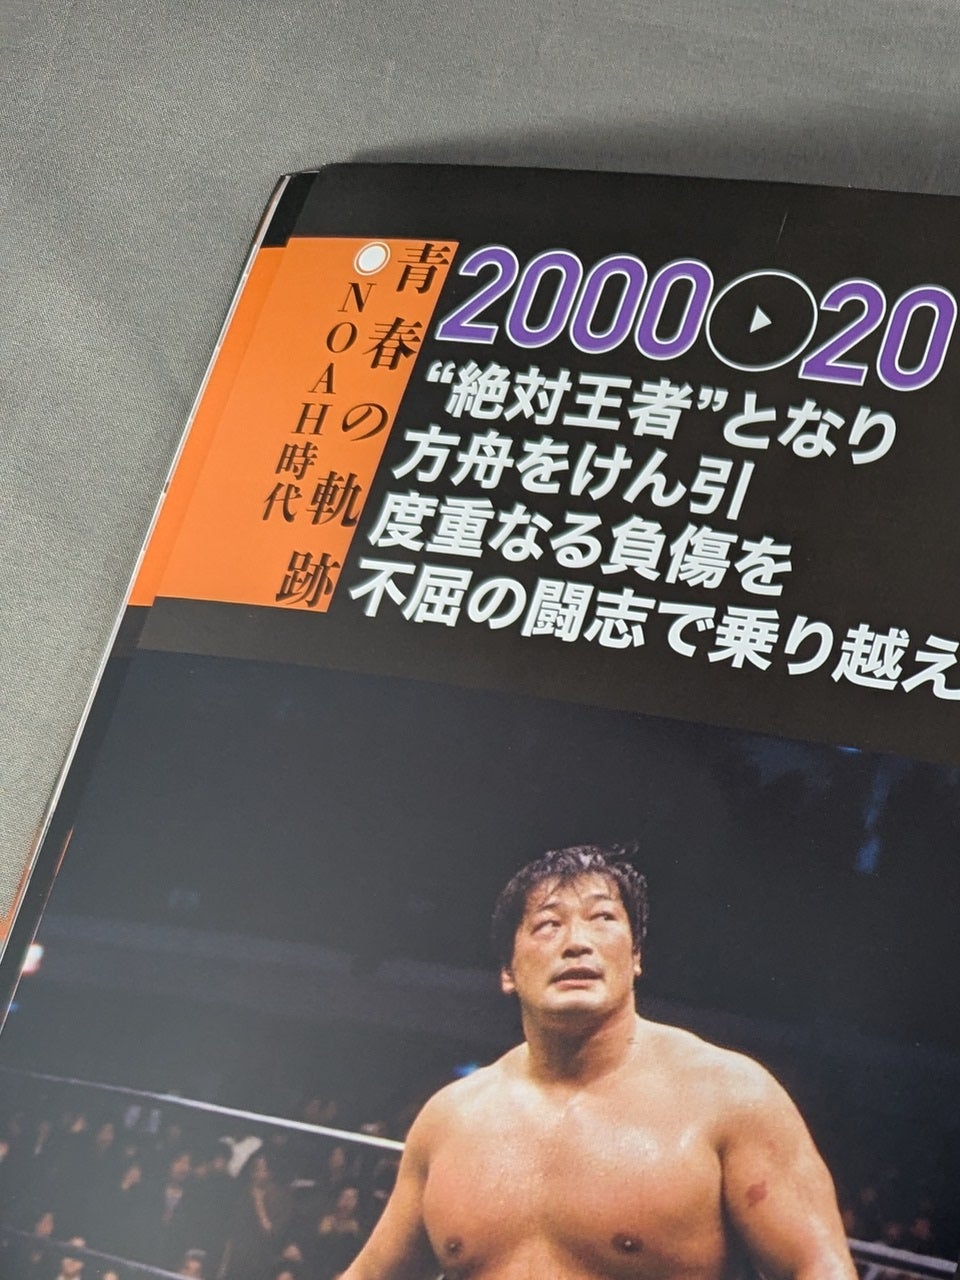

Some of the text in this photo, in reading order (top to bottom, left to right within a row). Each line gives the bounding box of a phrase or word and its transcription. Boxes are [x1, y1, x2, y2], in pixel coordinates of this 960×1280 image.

[435, 245, 714, 361] 2000
[262, 281, 376, 524] NOAH時代
[276, 242, 450, 607] 青春の軌跡
[391, 426, 755, 520] 方舟をけん引
[367, 492, 792, 596] 度重なる負傷を
